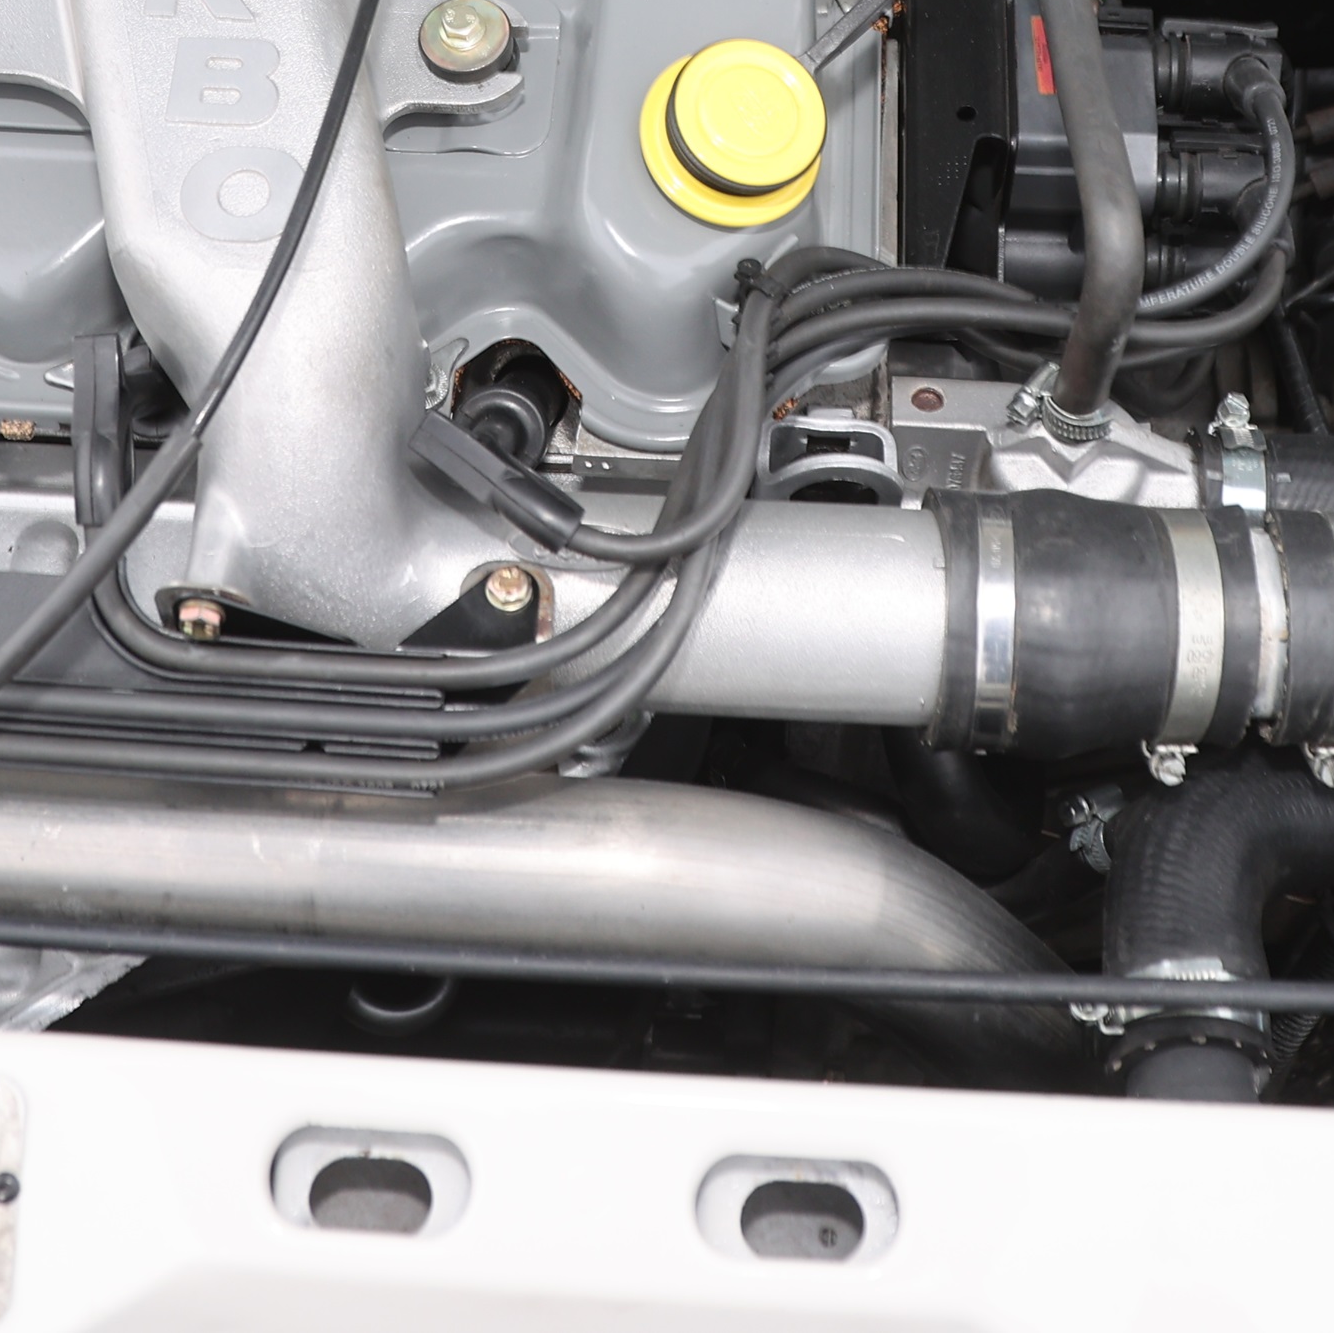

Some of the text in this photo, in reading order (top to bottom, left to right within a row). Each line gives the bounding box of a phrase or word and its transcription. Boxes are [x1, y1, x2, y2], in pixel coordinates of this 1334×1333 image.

[1139, 267, 1217, 309] MPERATURE
[1215, 235, 1256, 275] DOUBLE
[1253, 186, 1279, 236] SILICONE
